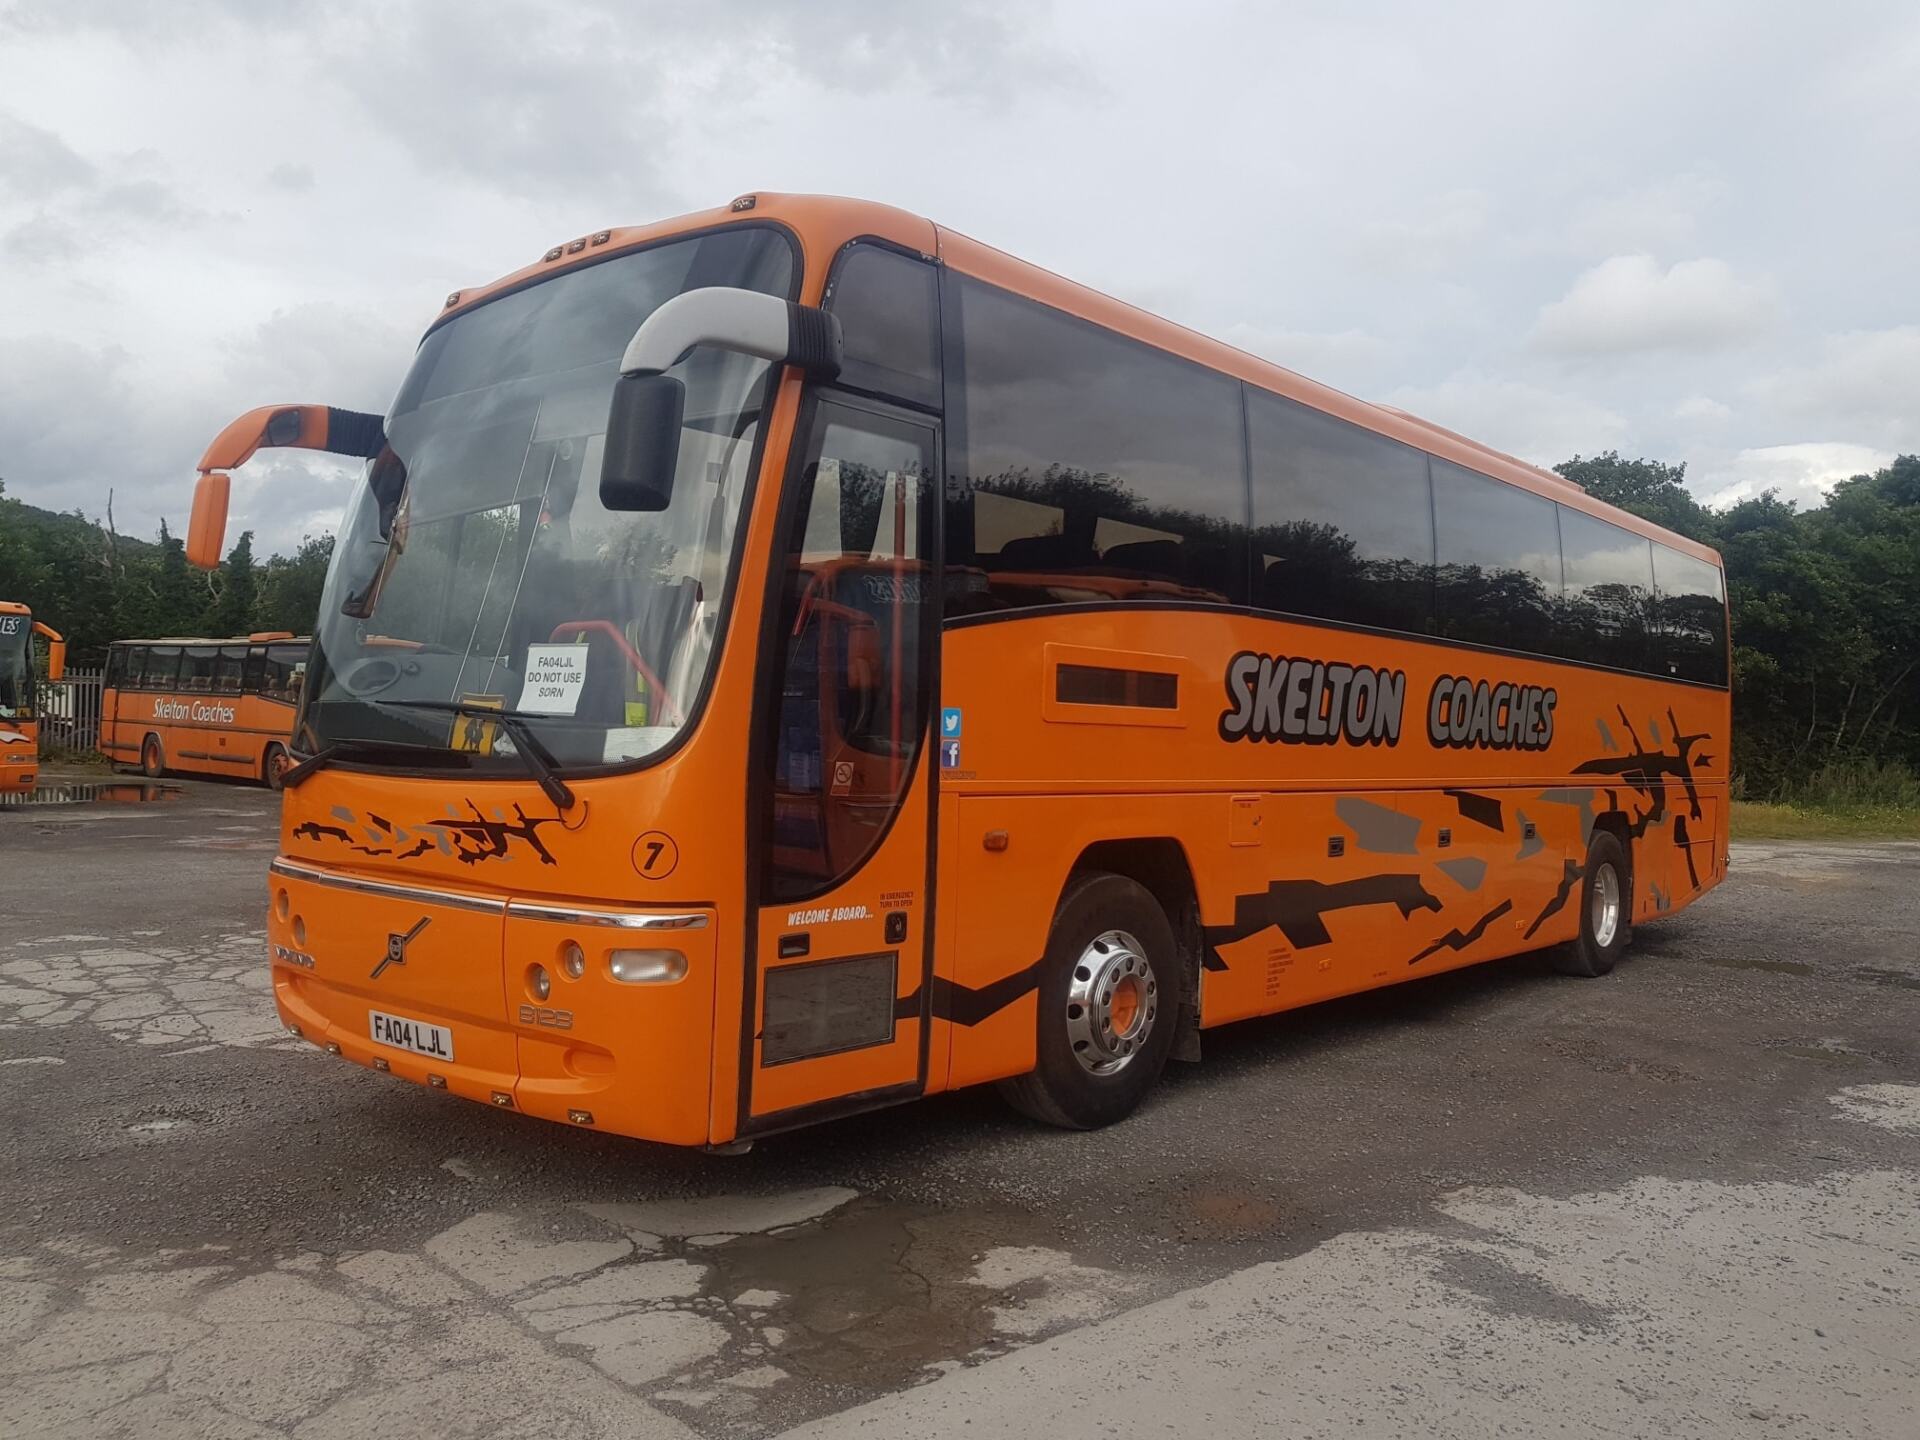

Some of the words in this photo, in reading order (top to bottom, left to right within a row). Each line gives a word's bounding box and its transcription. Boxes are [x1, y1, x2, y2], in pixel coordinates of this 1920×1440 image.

[538, 656, 574, 668] FA04LJL
[528, 671, 542, 683] DO
[543, 672, 562, 683] NOT
[563, 672, 582, 684] USE
[538, 687, 565, 698] SORN
[1218, 650, 1406, 747] SKELTON
[1427, 674, 1557, 751] COACHES
[152, 697, 189, 720] Skelton
[191, 700, 235, 723] Coaches
[643, 842, 665, 870] 7
[787, 908, 830, 926] WELCOME
[374, 1015, 412, 1047] FA04
[415, 1025, 447, 1056] LJL
